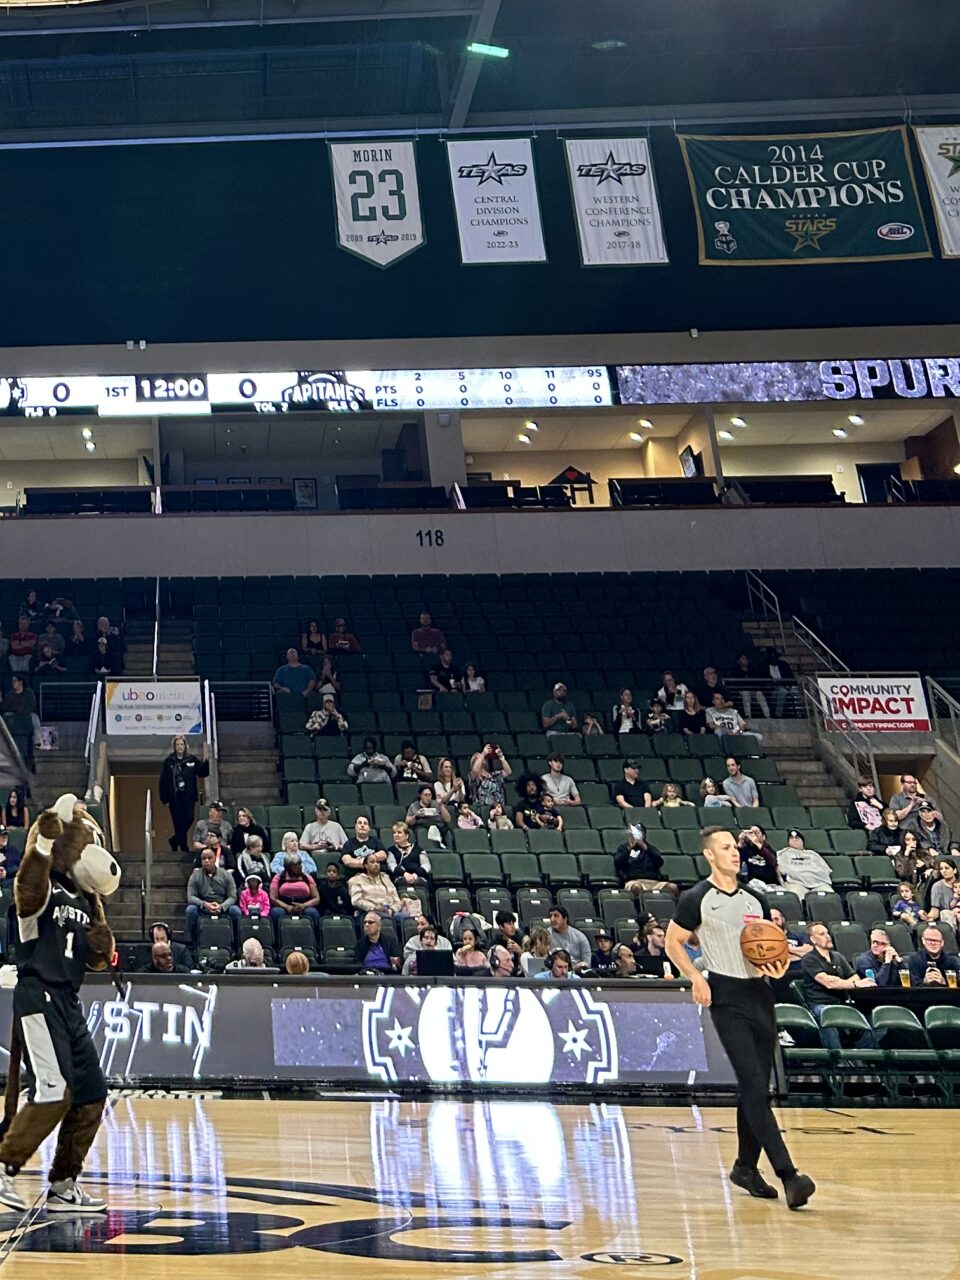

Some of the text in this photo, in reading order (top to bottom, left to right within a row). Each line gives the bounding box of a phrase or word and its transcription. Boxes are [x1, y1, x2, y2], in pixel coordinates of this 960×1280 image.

[352, 149, 392, 162] MORIN
[768, 144, 824, 163] 2014
[714, 159, 887, 186] CALDER CUP
[348, 168, 407, 222] 23
[474, 195, 520, 204] CENTRAL
[592, 195, 640, 205] WESTERN
[706, 180, 904, 210] CHAMPIONS
[476, 206, 520, 216] DIVISION
[585, 206, 653, 216] CONFERENCE
[470, 217, 529, 227] CHAMPIONS
[589, 218, 651, 228] CHAMPIONS
[785, 218, 837, 233] STARS
[401, 233, 417, 241] 2019
[887, 226, 908, 236] AHL
[486, 240, 520, 249] 2022-23
[606, 241, 641, 250] 2017-18
[414, 369, 602, 382] 2 5 10 11 95
[52, 377, 366, 405] 0 1ST 12:00 0 CAPITANES
[375, 385, 397, 395] PTS
[376, 398, 398, 408] FLS
[415, 530, 445, 547] 118
[122, 687, 155, 701] ubeo
[830, 685, 912, 697] COMMUNITY
[833, 697, 915, 715] IMPACT
[841, 721, 915, 729] CMMUNITYIMPACT.COM
[64, 932, 74, 959] 1
[100, 1001, 213, 1048] STIN
